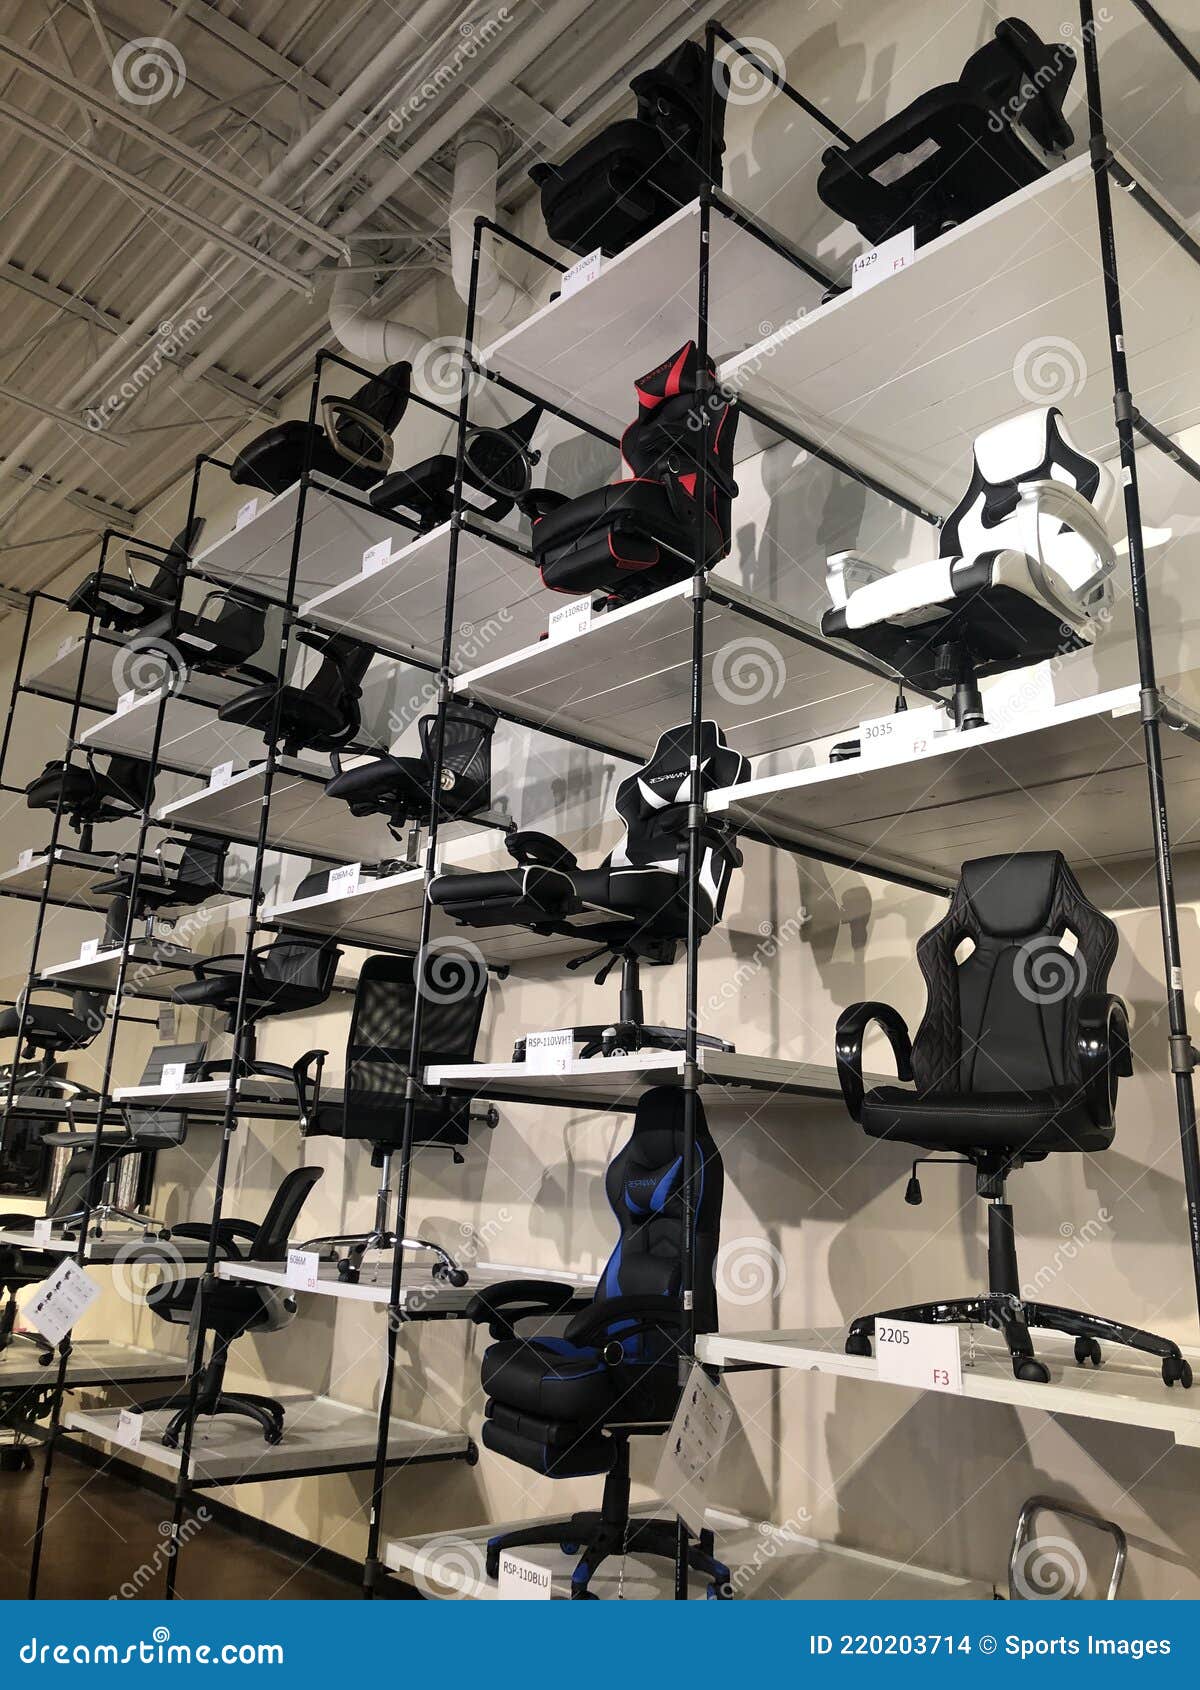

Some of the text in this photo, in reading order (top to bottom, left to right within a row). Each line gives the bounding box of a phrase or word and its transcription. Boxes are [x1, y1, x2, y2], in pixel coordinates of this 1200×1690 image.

[854, 252, 878, 273] 1429
[893, 256, 905, 271] F1
[552, 600, 590, 625] RSP-110RED
[864, 721, 893, 740] 3035
[913, 740, 928, 754] F2
[528, 1034, 572, 1048] RSP-110WHT
[879, 1326, 910, 1345] 2205
[933, 1368, 950, 1386] F3
[503, 1560, 549, 1588] RSP-110BLU
